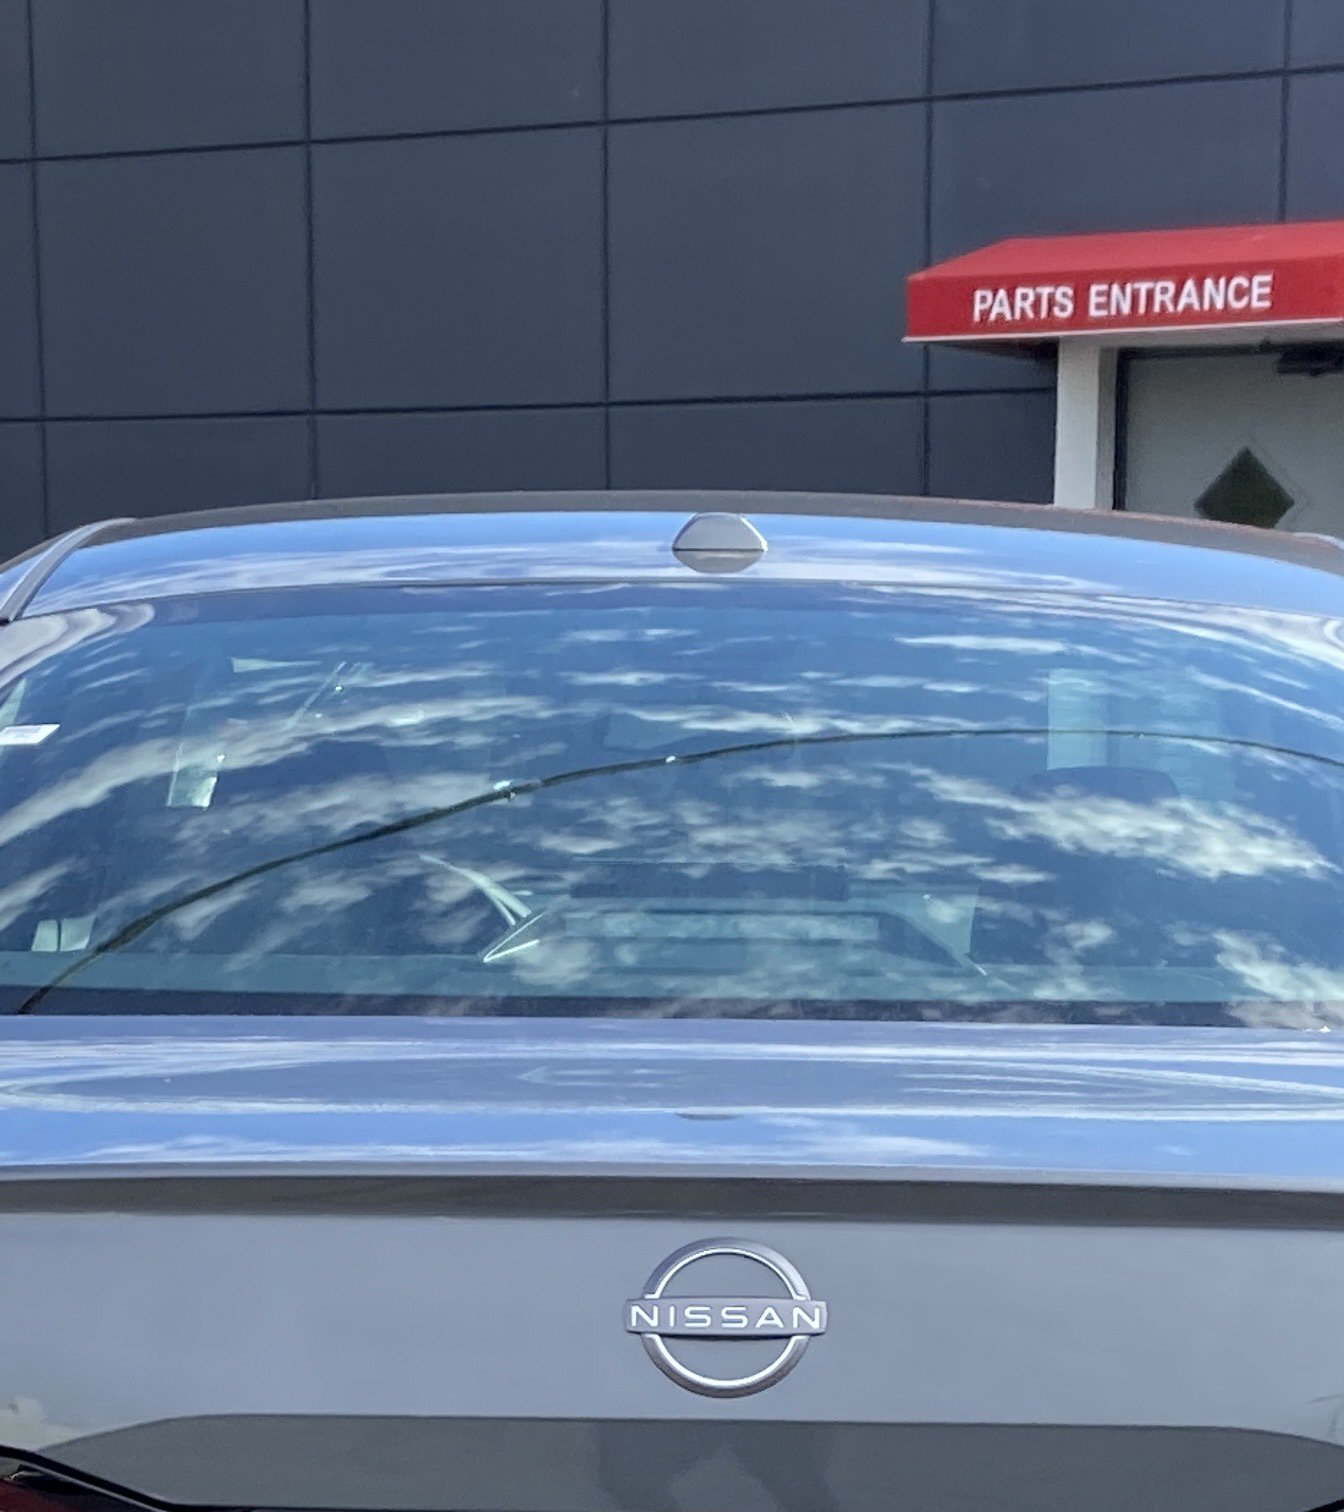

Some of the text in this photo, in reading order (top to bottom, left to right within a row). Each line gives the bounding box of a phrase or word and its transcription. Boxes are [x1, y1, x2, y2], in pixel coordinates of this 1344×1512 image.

[972, 271, 1274, 322] PARTS ENTRANCE
[631, 1304, 821, 1329] NISSAN
